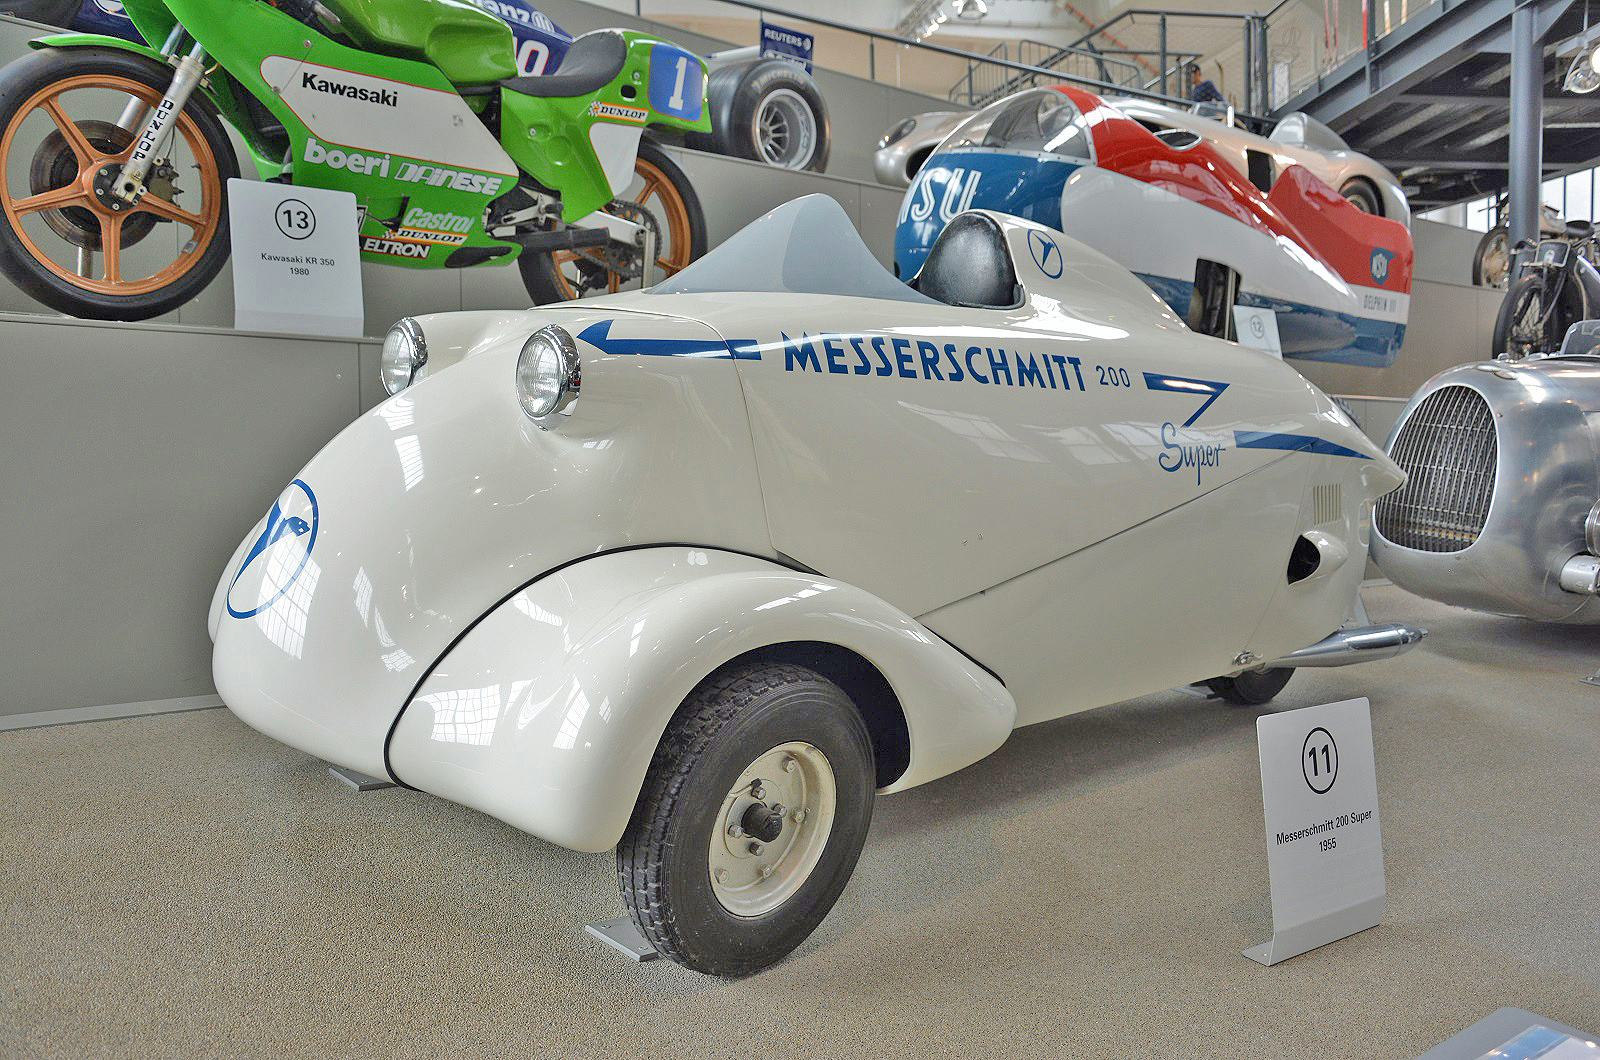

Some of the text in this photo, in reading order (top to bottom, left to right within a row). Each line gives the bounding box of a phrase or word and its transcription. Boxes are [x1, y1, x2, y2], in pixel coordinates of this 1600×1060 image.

[764, 28, 802, 48] REUTERS
[513, 36, 550, 77] 0
[302, 72, 398, 107] Kawasaki
[667, 56, 689, 111] 1
[600, 106, 646, 119] DUNLOP
[132, 99, 175, 161] DUNLOP
[303, 137, 391, 178] boeri
[282, 209, 309, 230] 13
[402, 207, 475, 233] Castrol
[364, 238, 431, 259] ELTRON
[400, 230, 464, 244] DUNLOP
[261, 252, 335, 267] Kawasaki KR 350
[289, 266, 310, 276] 1980
[1251, 320, 1263, 333] 12
[780, 330, 1131, 392] MESSERSCHMITT 200
[1158, 421, 1226, 487] Super
[1308, 744, 1331, 777] 11
[1276, 810, 1372, 846] Messerschmitt 200 Super
[1318, 837, 1337, 852] 1955
